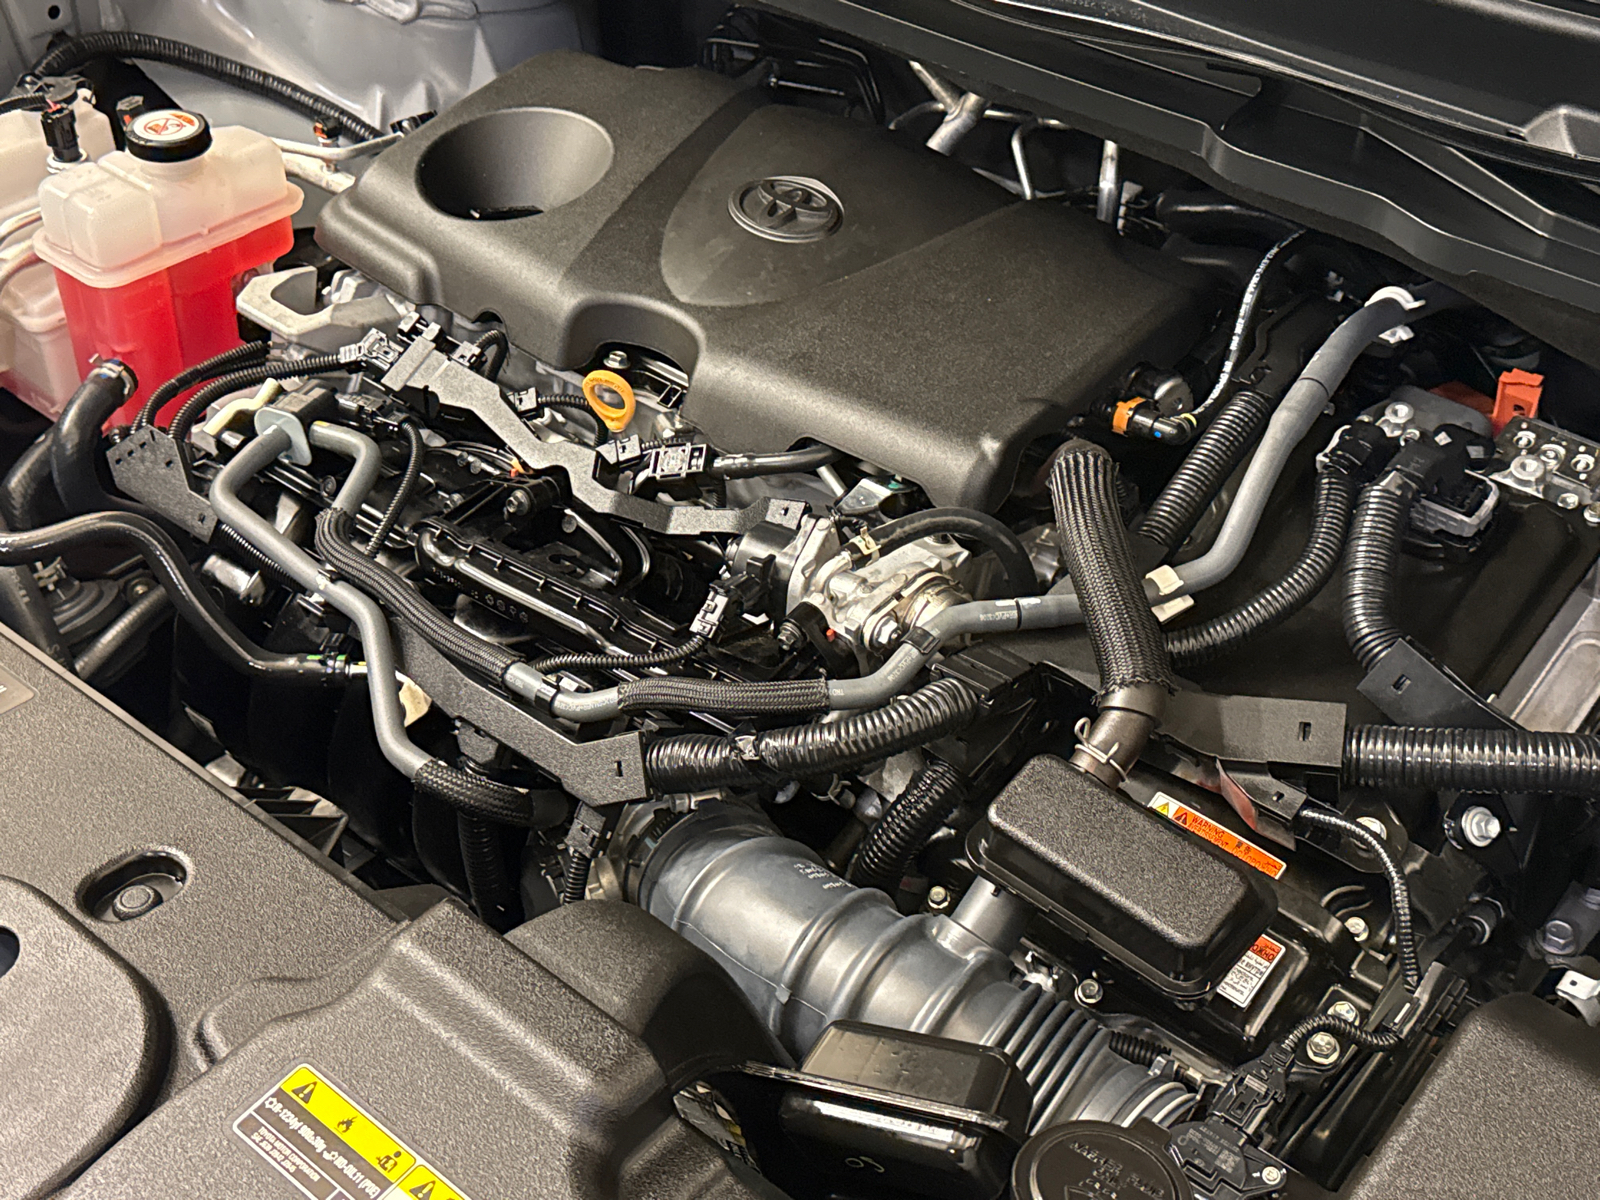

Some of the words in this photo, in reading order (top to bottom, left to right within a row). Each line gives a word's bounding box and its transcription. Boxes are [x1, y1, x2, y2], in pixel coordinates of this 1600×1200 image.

[1192, 815, 1225, 838] WARNING
[258, 1126, 277, 1144] TOYOTA
[273, 1140, 292, 1156] MOTOR
